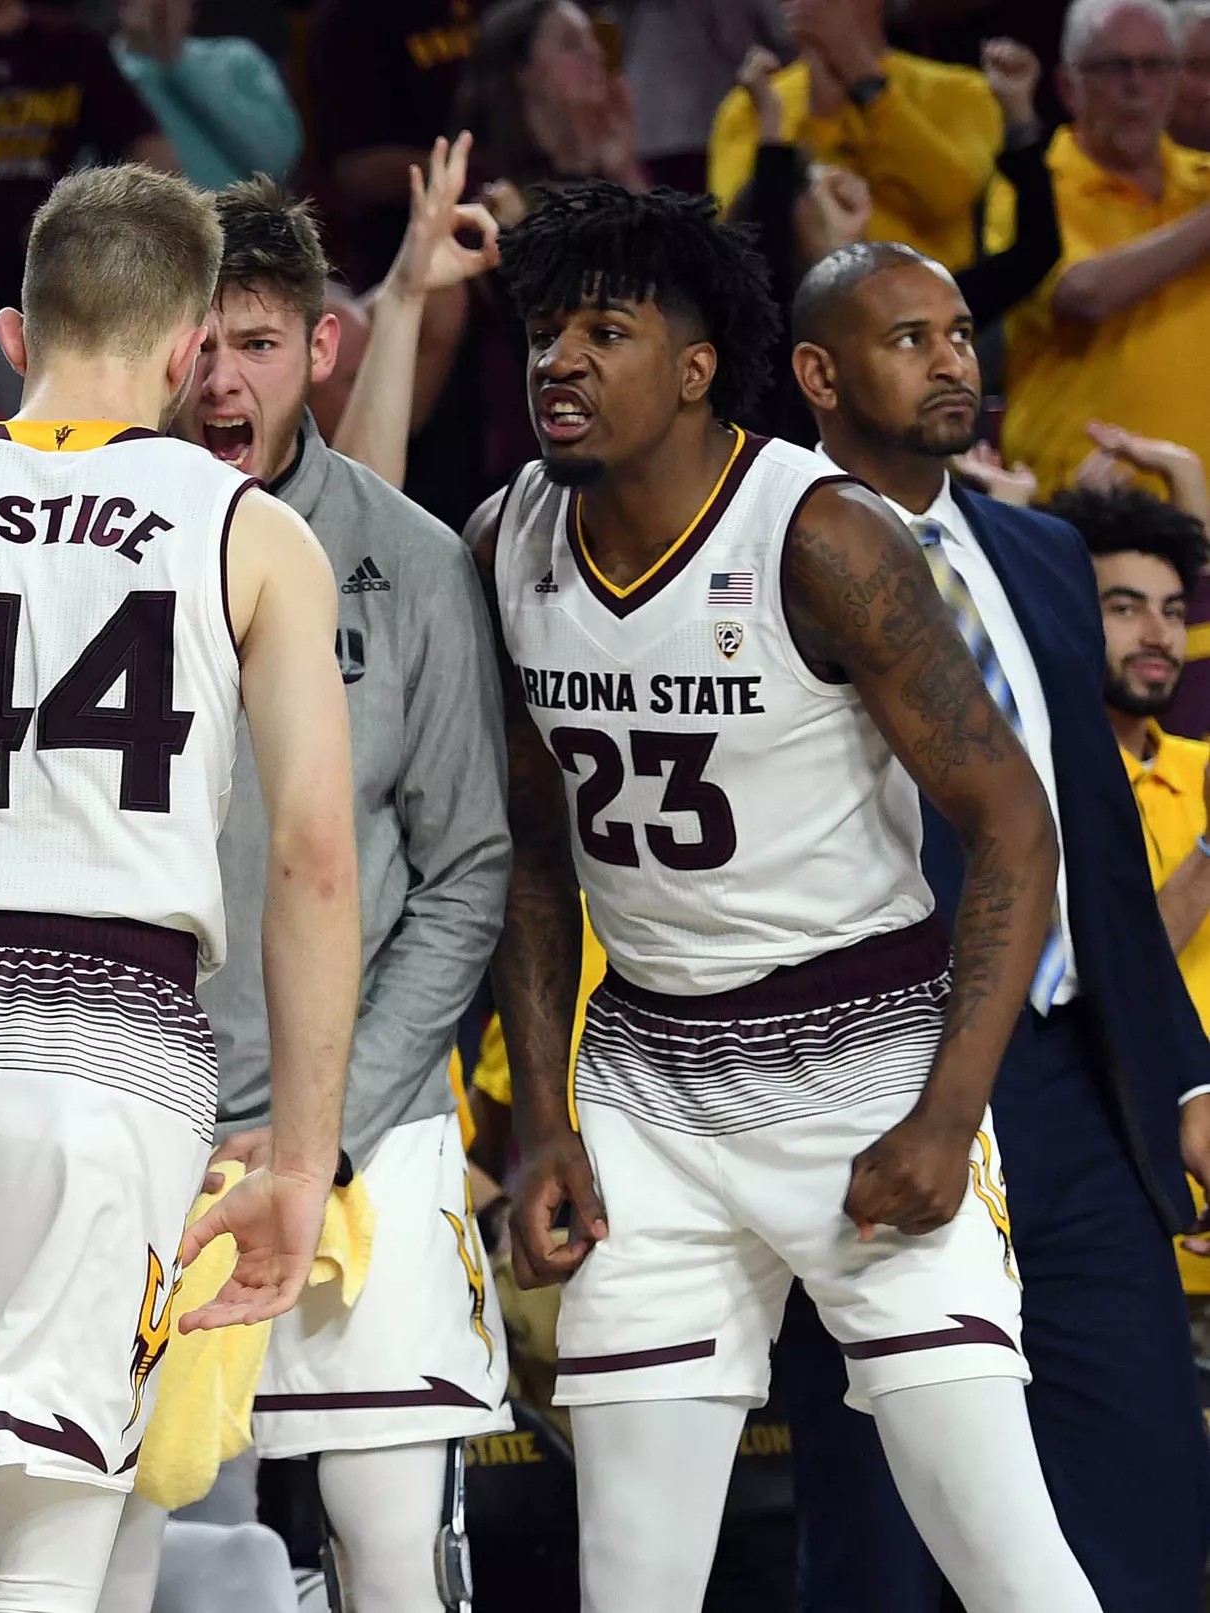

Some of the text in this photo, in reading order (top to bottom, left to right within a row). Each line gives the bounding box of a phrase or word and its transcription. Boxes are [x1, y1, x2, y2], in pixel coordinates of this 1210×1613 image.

[341, 579, 391, 594] adidas
[516, 665, 766, 715] RIZONA STATE
[550, 726, 737, 870] 23
